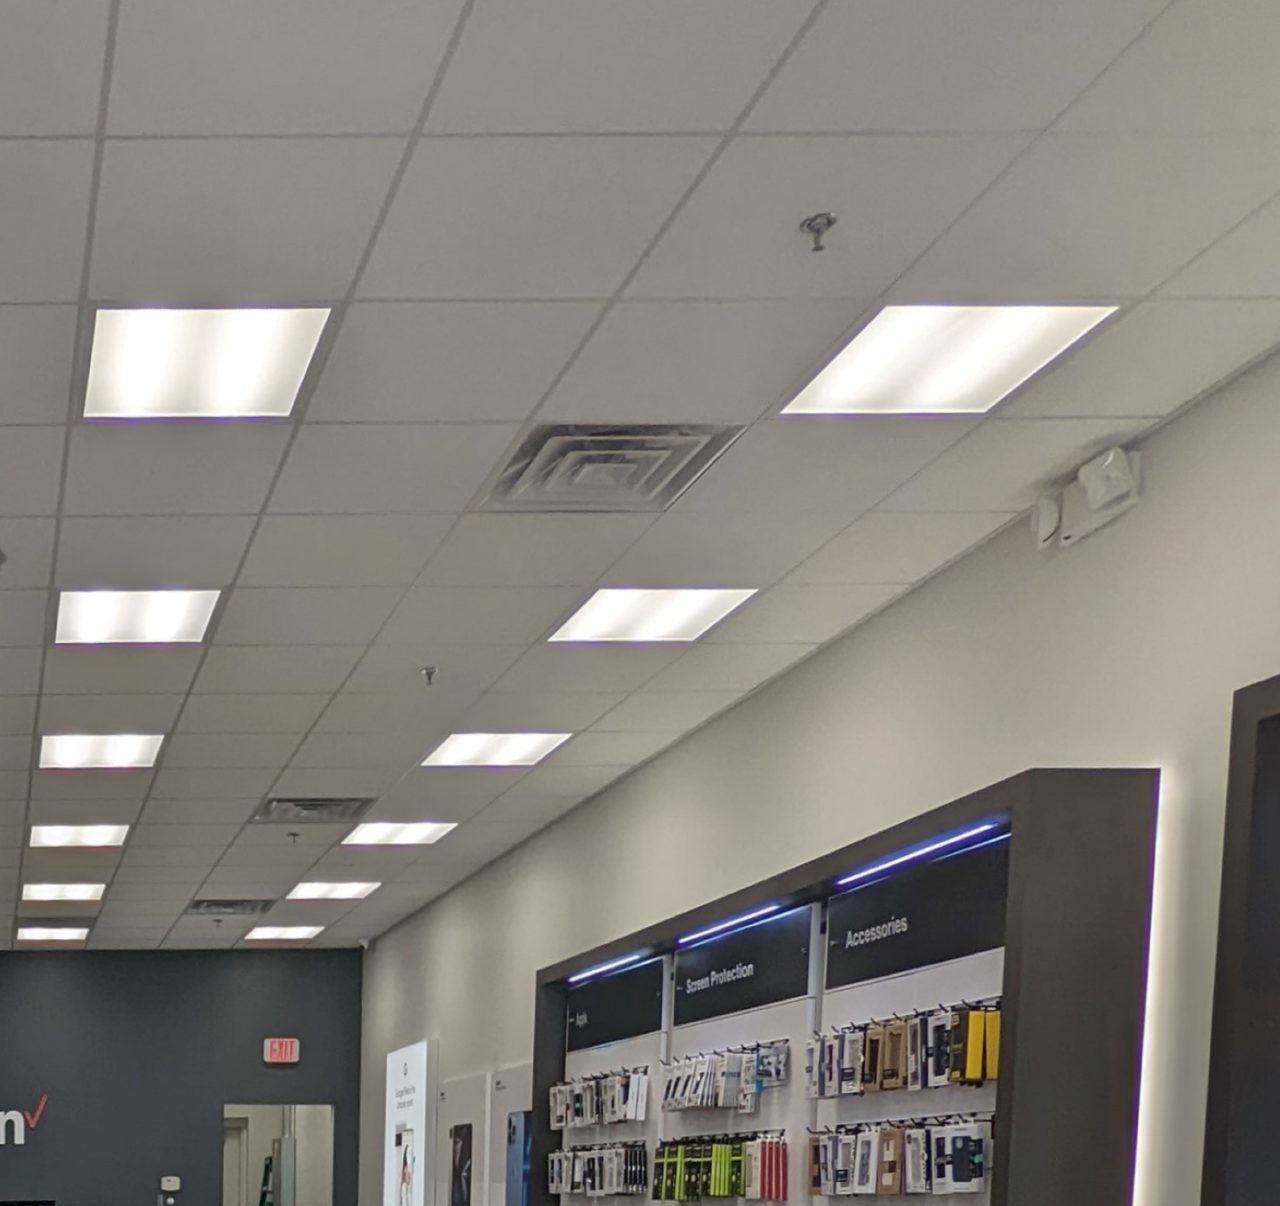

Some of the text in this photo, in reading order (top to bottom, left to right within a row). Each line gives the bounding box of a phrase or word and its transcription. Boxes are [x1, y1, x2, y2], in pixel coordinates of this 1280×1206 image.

[845, 916, 908, 948] Accessories
[686, 962, 754, 994] Screen Protection
[269, 1040, 297, 1060] EXIT
